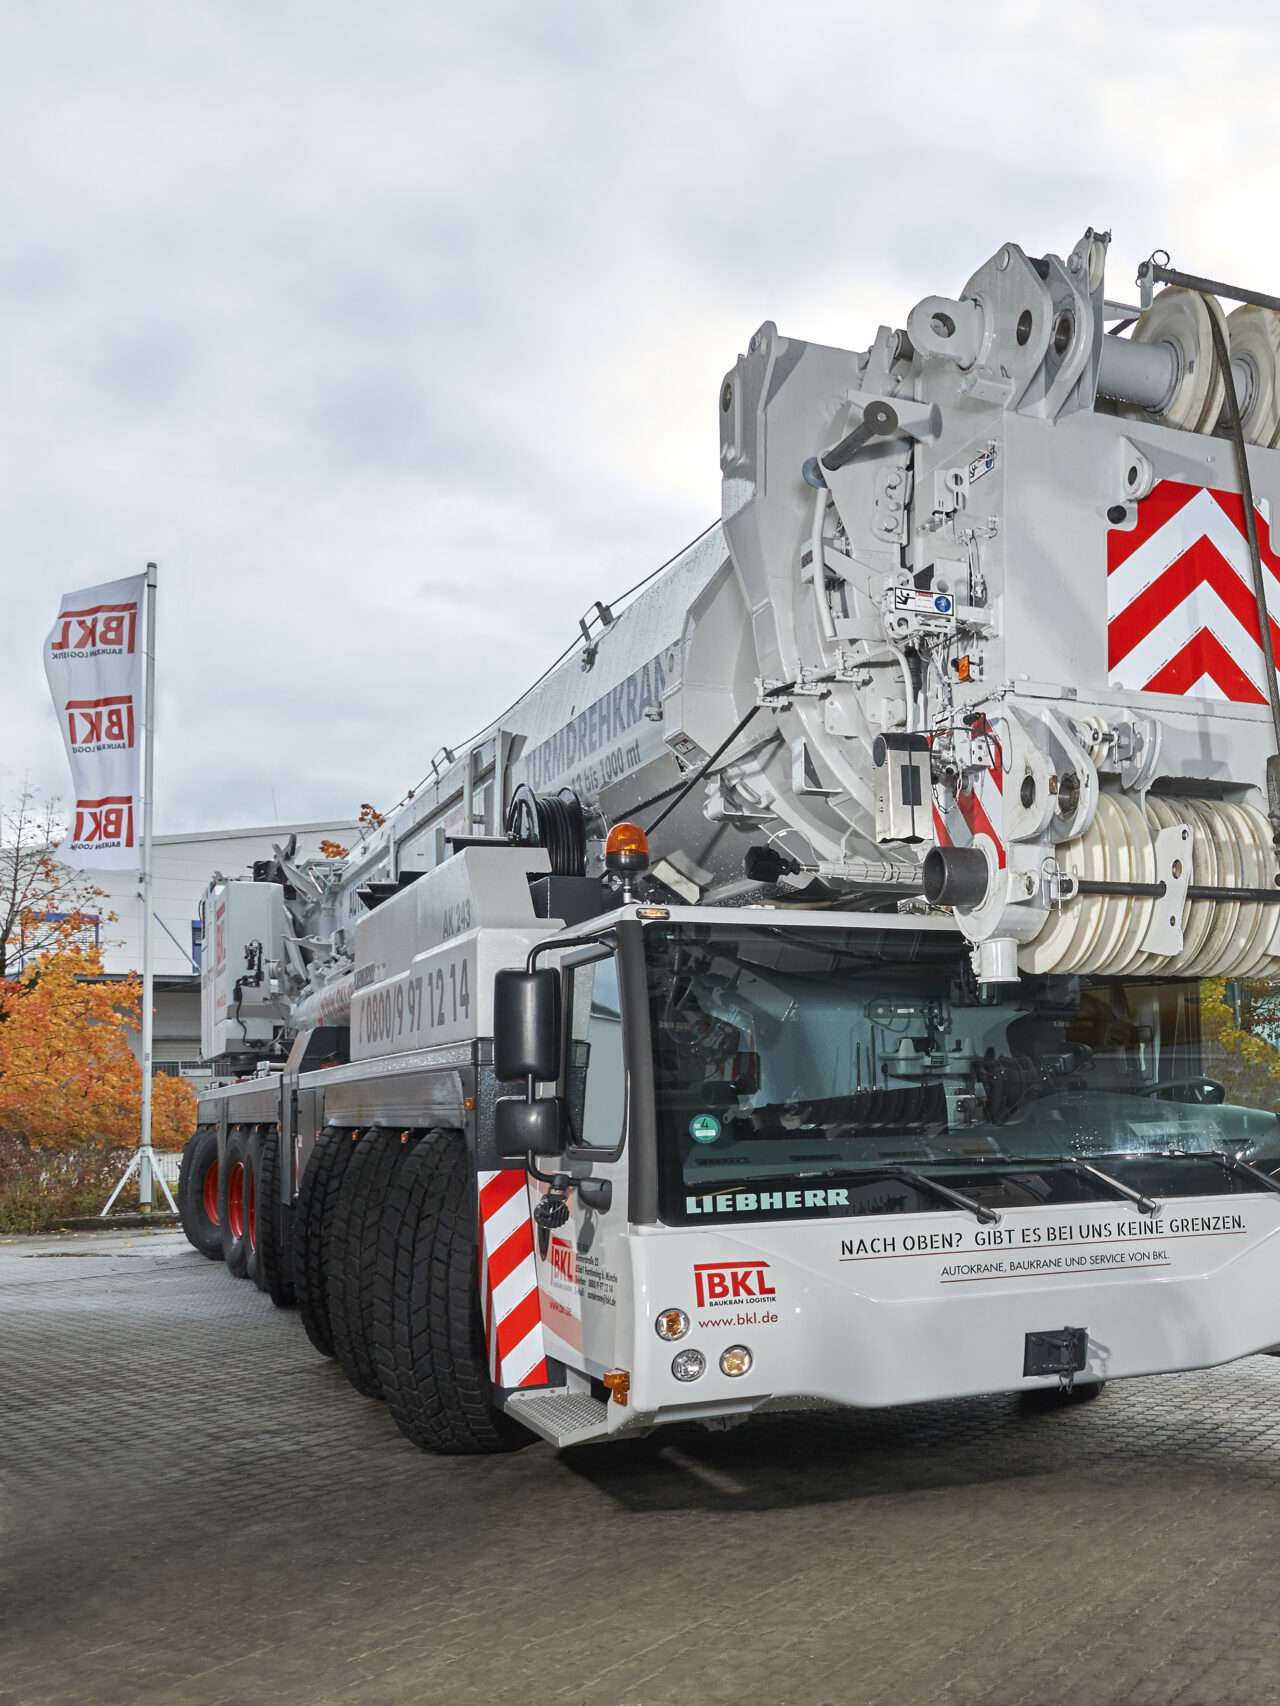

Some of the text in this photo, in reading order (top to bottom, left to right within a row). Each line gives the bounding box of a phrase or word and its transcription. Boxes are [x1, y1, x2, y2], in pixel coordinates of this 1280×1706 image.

[600, 746, 625, 784] 1000
[407, 976, 422, 1033] 97
[428, 967, 446, 1028] 12
[450, 958, 470, 1022] 14
[685, 1188, 850, 1214] LIEBHERR
[841, 1215, 1247, 1256] NACH OBEN? GIBT ES BEI UNS KEINE GRENZEN.
[941, 1250, 1171, 1277] AUTOKRANE, BAUKRANE UND SERVICE VON BKL.
[706, 1269, 777, 1300] BKL
[709, 1295, 777, 1308] BAUKRAN LOGISTIK
[698, 1311, 779, 1329] www.bkl.de
